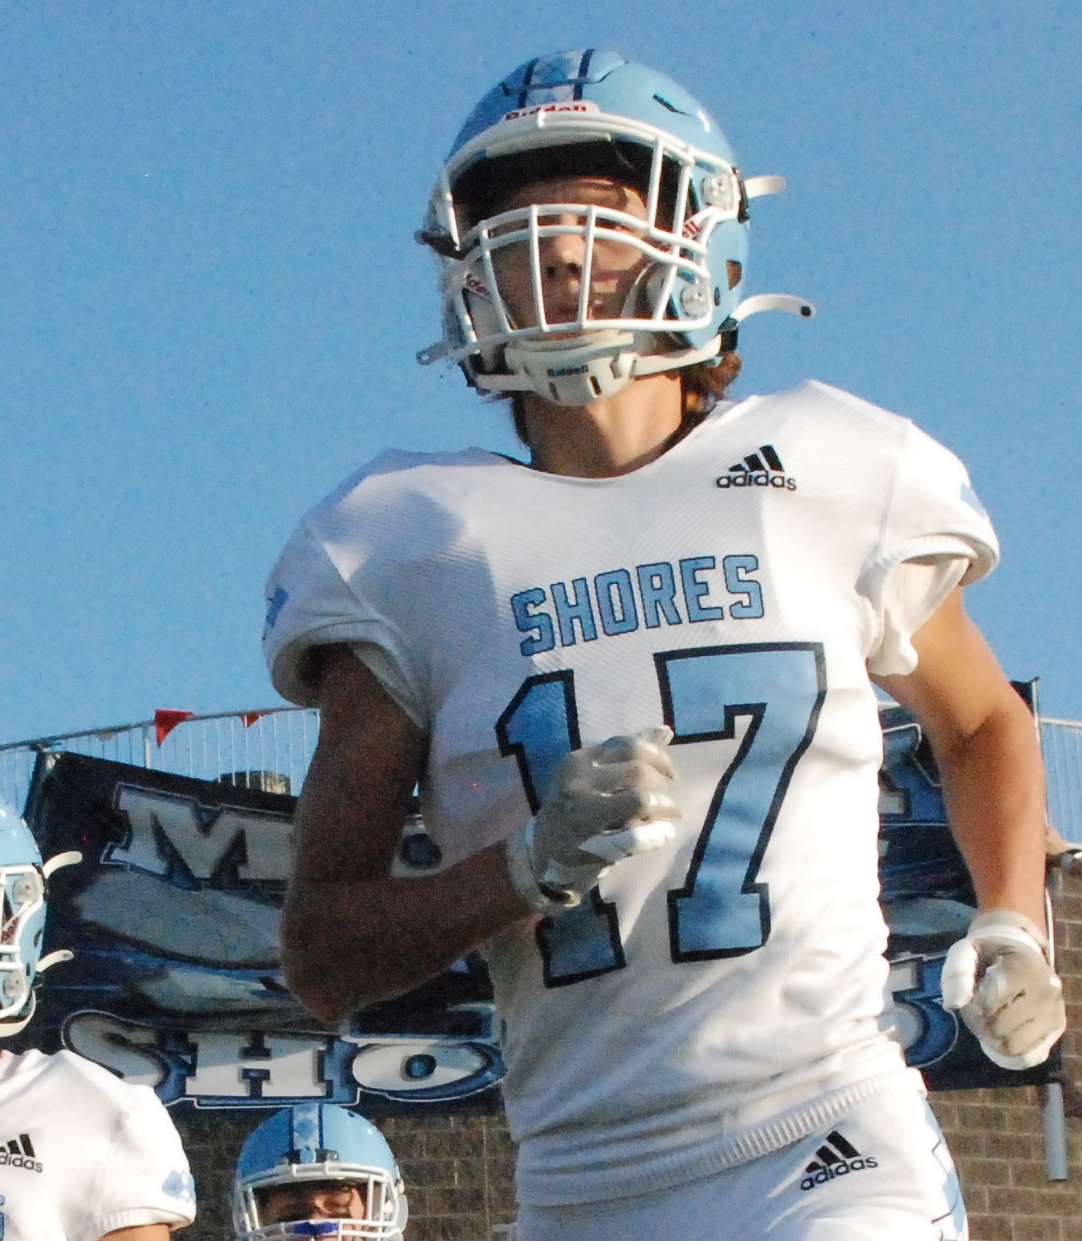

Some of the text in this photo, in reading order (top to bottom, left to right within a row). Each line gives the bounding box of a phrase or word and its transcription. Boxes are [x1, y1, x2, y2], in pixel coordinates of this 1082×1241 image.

[715, 469, 797, 492] adidas
[510, 554, 765, 657] SHORES
[494, 640, 828, 990] 17
[800, 1157, 879, 1191] adidas
